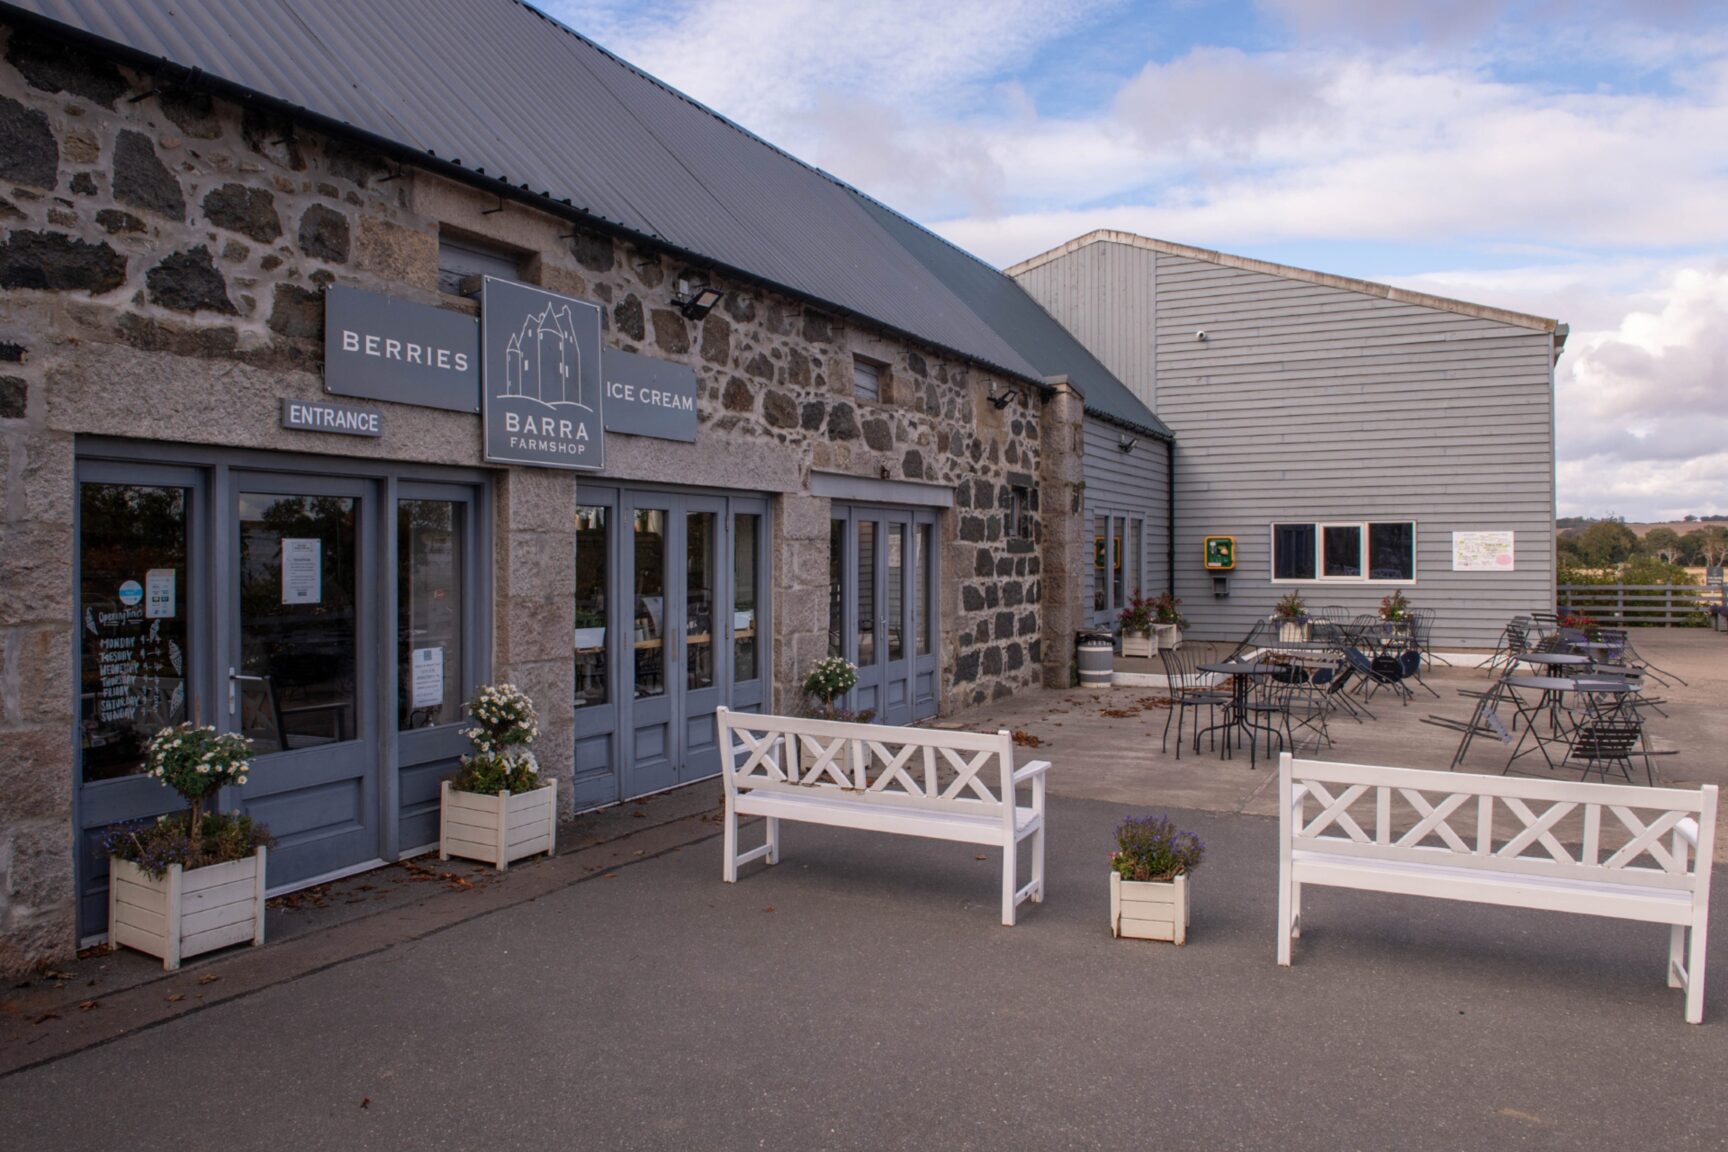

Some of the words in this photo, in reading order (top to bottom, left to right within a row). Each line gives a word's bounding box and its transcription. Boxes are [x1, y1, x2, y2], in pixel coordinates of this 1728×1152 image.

[342, 329, 469, 372] BERRIES
[606, 381, 635, 401] ICE
[639, 388, 694, 412] CREAM
[289, 404, 379, 432] ENTRANCE
[505, 412, 590, 441] BARRA
[510, 436, 586, 455] FARMSHOP
[100, 636, 136, 649] MONDAY
[98, 650, 133, 663] TUESDAY
[101, 706, 135, 722] SUNDAY
